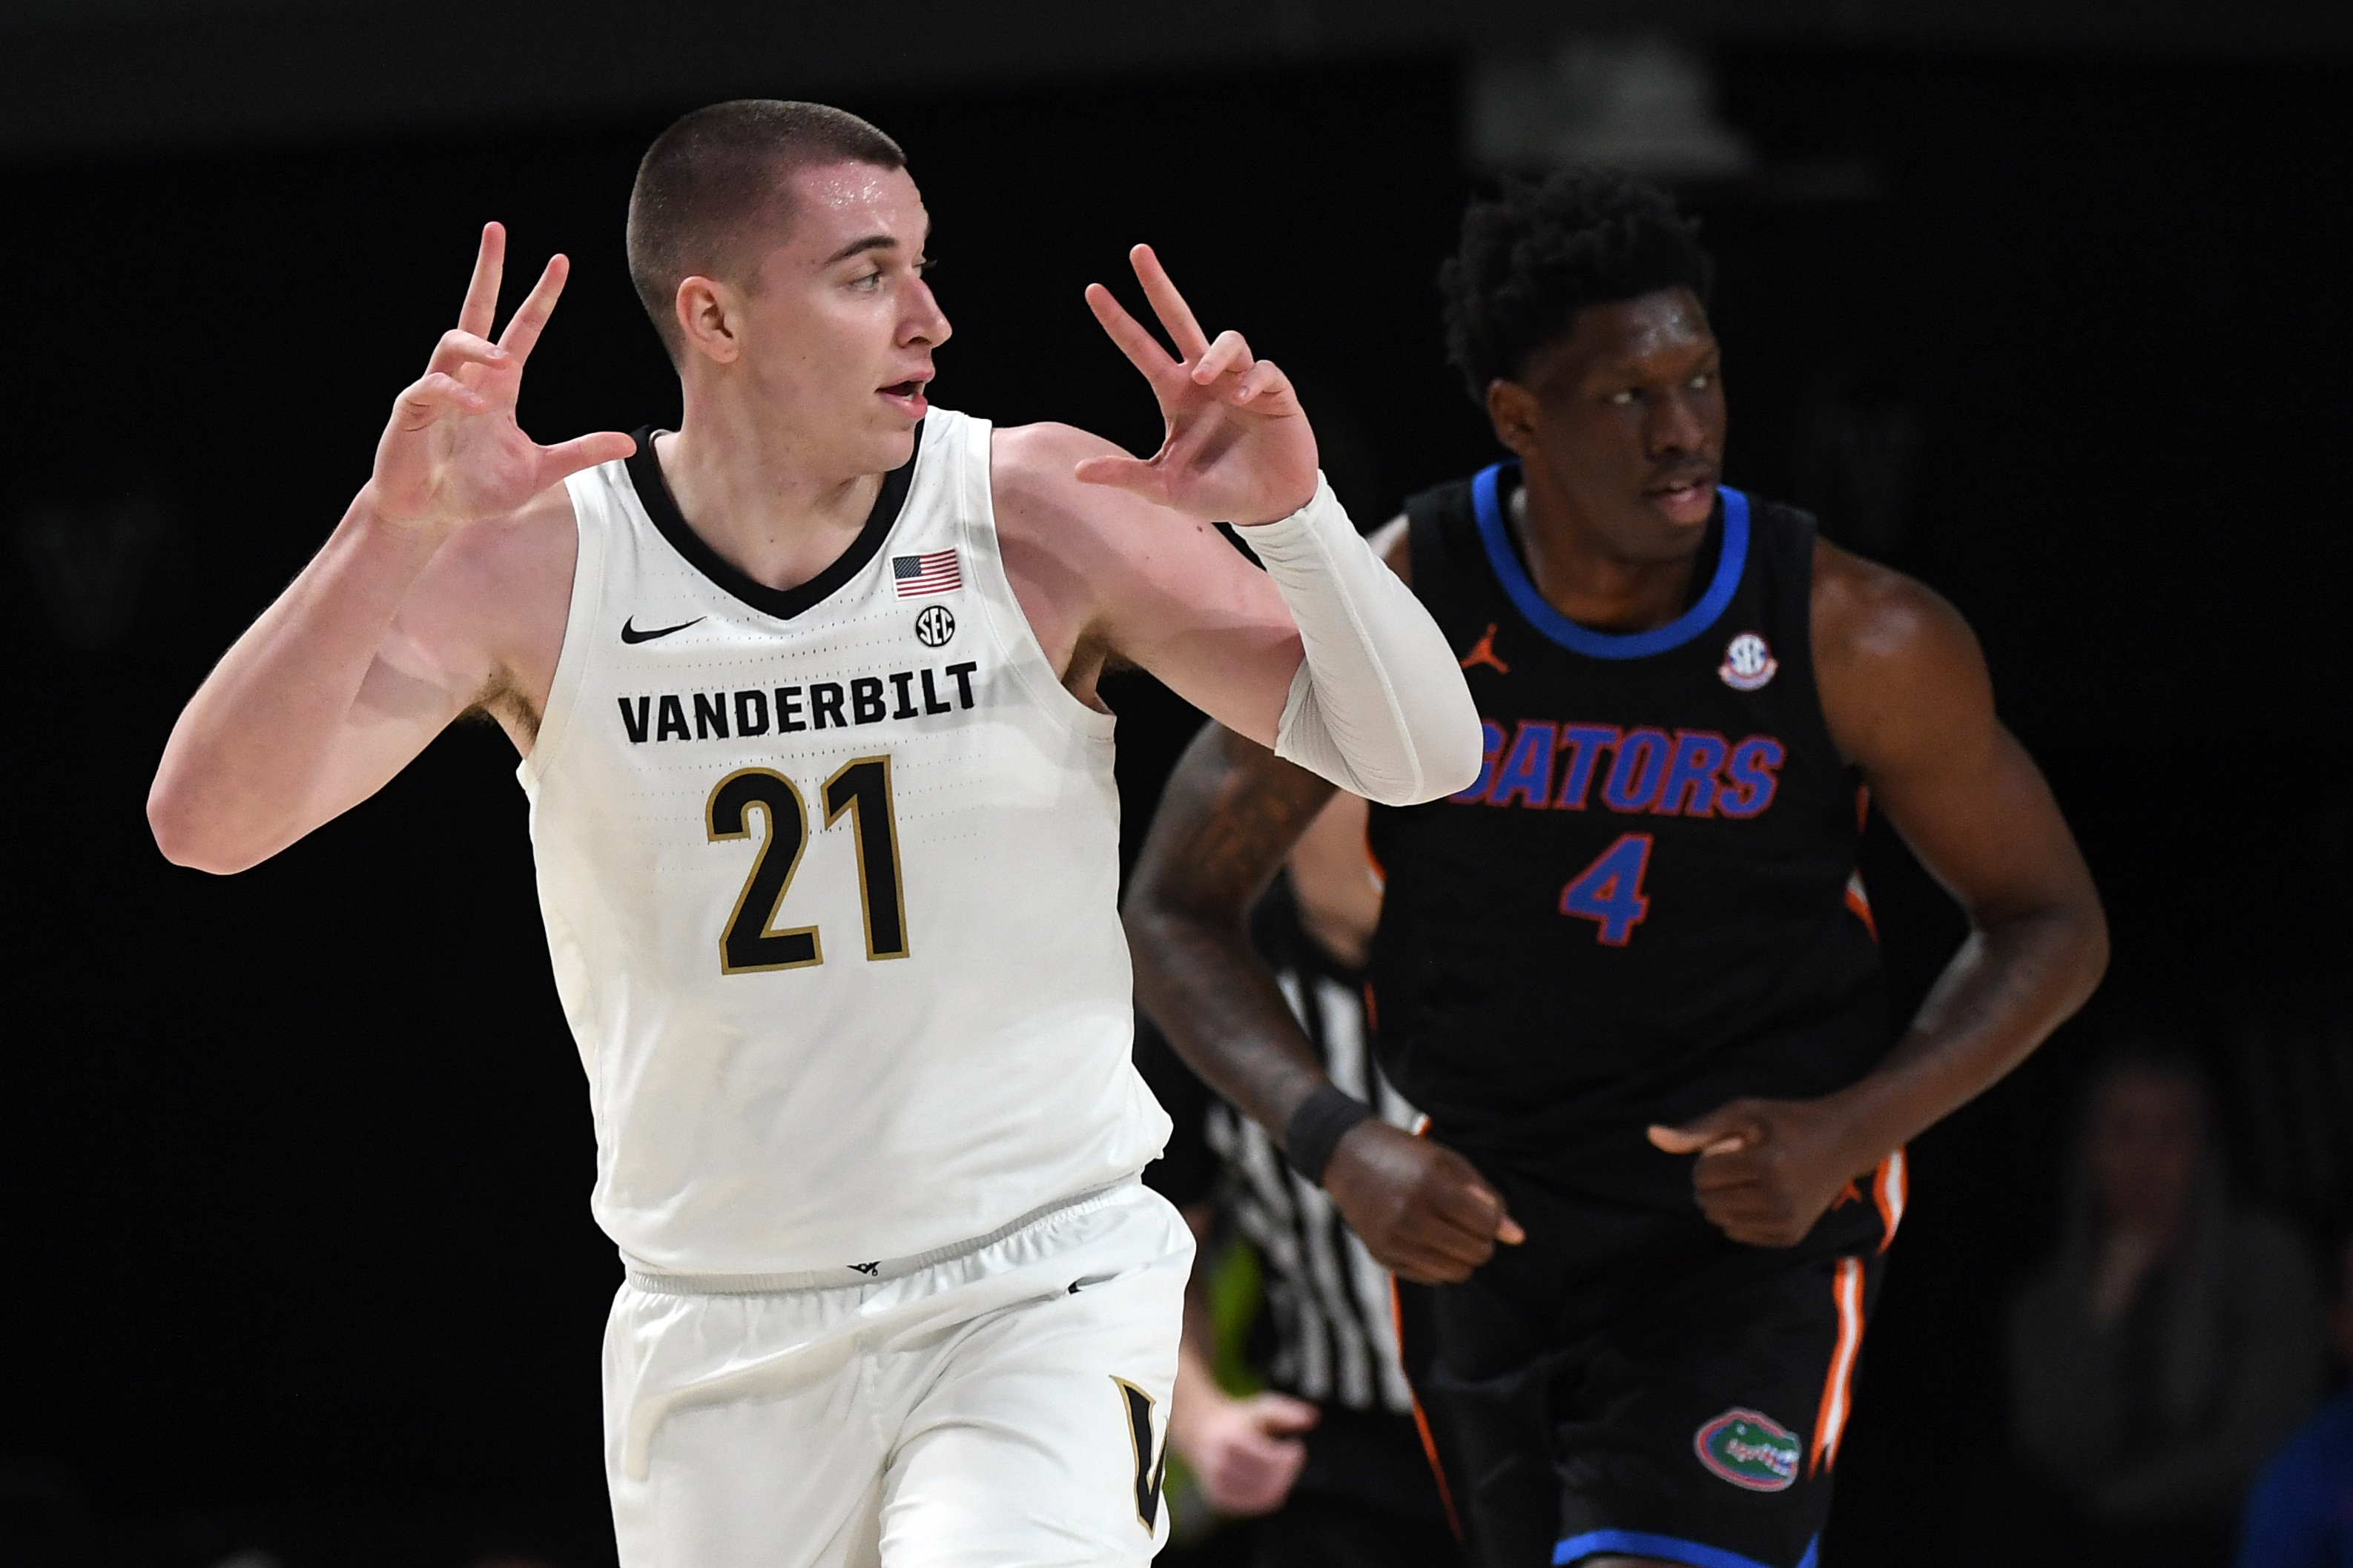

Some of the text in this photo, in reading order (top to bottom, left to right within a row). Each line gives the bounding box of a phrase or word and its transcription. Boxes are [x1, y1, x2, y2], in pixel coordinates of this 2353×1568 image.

[918, 607, 953, 645] SEC
[618, 661, 977, 743] VANDERBILT
[705, 754, 910, 975] 21
[1560, 833, 1654, 947] 4
